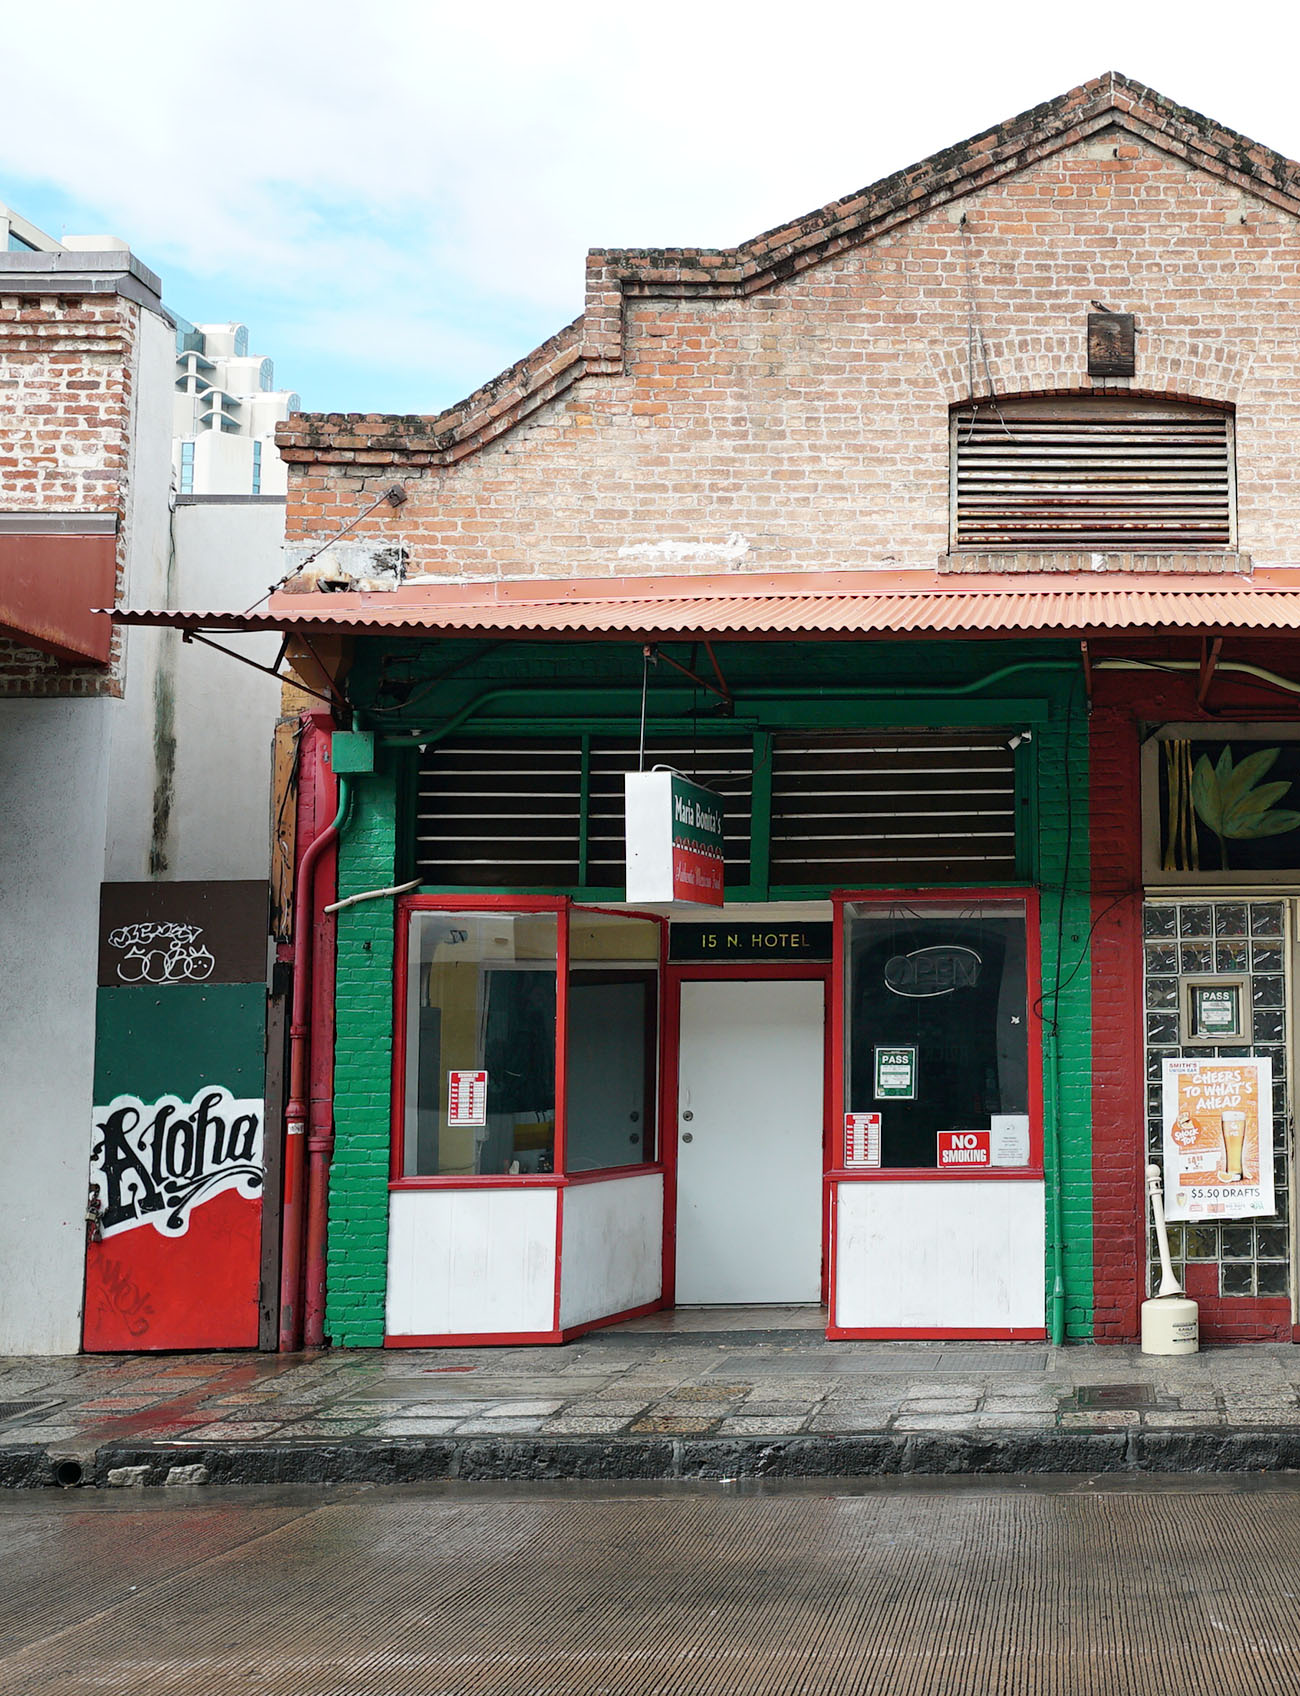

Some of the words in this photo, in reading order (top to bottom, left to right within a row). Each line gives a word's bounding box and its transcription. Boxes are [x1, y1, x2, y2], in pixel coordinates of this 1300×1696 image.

[674, 794, 694, 826] Maria
[695, 802, 721, 834] Bonita's
[702, 934, 717, 948] 15
[727, 934, 742, 948] N.
[751, 934, 810, 948] HOTEL
[884, 955, 981, 986] OPEN
[1203, 992, 1230, 1000] PASS
[882, 1055, 909, 1064] PASS
[1192, 1070, 1241, 1084] CHEERS
[1183, 1086, 1200, 1098] TO
[1204, 1081, 1253, 1096] WHAT'S
[1196, 1095, 1241, 1110] AHEAD
[1174, 1128, 1199, 1140] SHOCK
[1181, 1136, 1196, 1145] TOP
[951, 1134, 978, 1149] NO
[93, 1093, 259, 1228] Aloha
[942, 1149, 987, 1163] SMOKING
[1191, 1188, 1219, 1198] $5.50
[1222, 1188, 1260, 1198] DRAFTS
